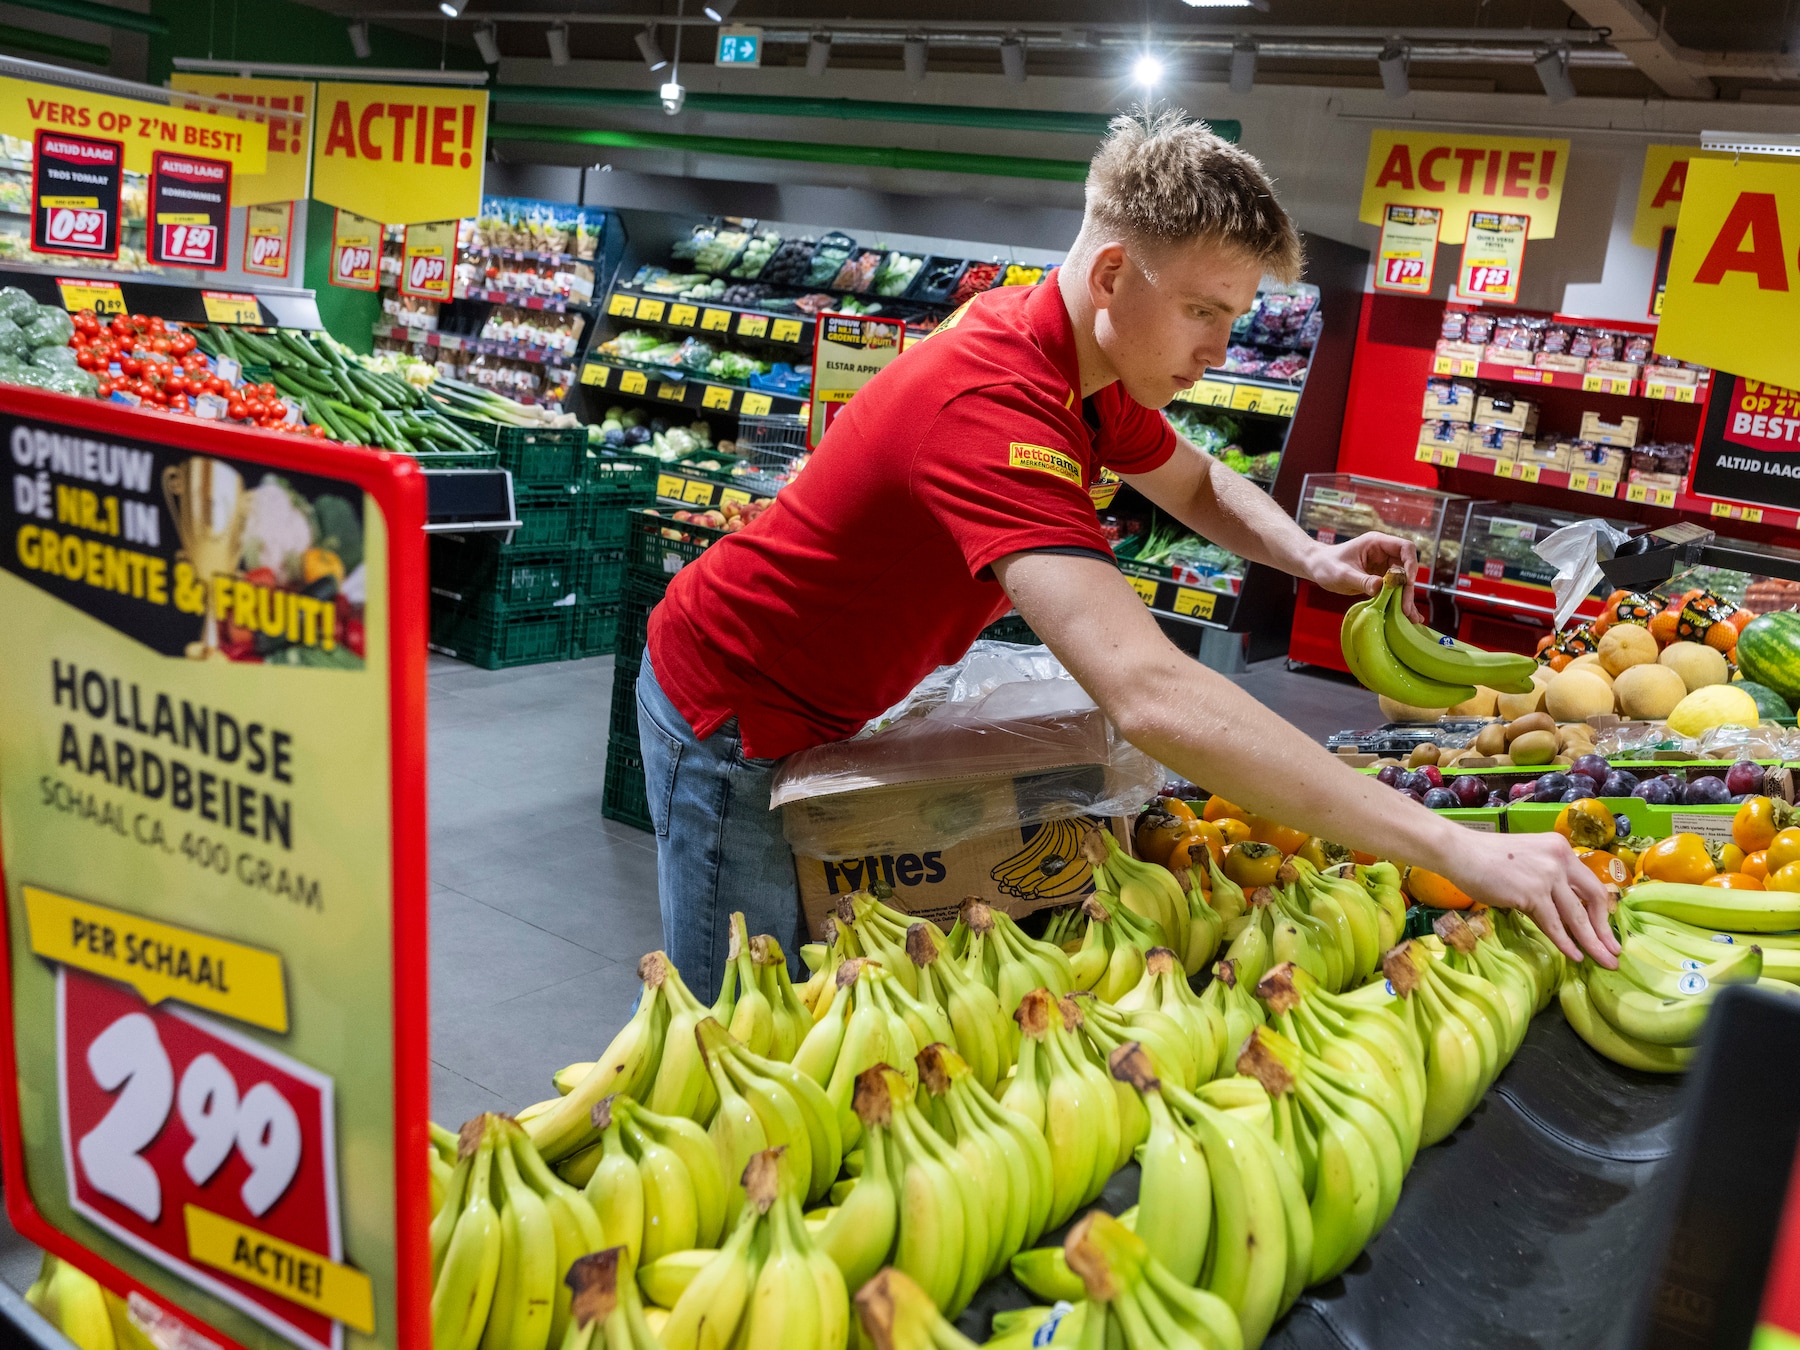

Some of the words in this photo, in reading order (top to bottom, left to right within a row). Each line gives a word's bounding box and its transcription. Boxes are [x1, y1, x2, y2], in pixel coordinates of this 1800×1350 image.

[27, 97, 92, 128] VERS
[97, 111, 132, 134] OP
[184, 126, 243, 153] BEST!
[45, 141, 79, 156] ALTIJD
[82, 145, 114, 161] LAAG!
[324, 100, 476, 169] ACTIE!
[47, 168, 72, 181] TROS
[72, 171, 109, 186] TOMAAT
[161, 160, 193, 174] ALTIJD
[193, 165, 224, 179] LAAG!
[161, 187, 222, 204] KOMKOMMERS
[1375, 144, 1557, 201] ACTIE!
[827, 332, 860, 343] GROENTE
[829, 317, 860, 328] OPNIEUW
[826, 360, 855, 371] ELSTAR
[857, 365, 882, 375] APPE
[1741, 394, 1771, 413] OP
[10, 425, 154, 493] OPNIEUW
[1014, 446, 1079, 478] Nettorama
[1716, 454, 1761, 473] ALTIJD
[13, 471, 53, 520] DÉ
[56, 484, 120, 537] NR.1
[123, 499, 161, 548] IN
[17, 524, 169, 604] GROENTE
[174, 562, 206, 615] &
[215, 573, 337, 652] FRUIT!
[51, 658, 293, 786] HOLLANDSE
[58, 722, 293, 851] AARDBEIEN
[39, 773, 128, 838] SCHAAL
[133, 813, 174, 856] CA.
[180, 833, 231, 876] 400
[235, 852, 325, 914] GRAM
[71, 916, 120, 960] PER
[125, 935, 231, 995] SCHAAL
[232, 1234, 323, 1300] ACTIE!
